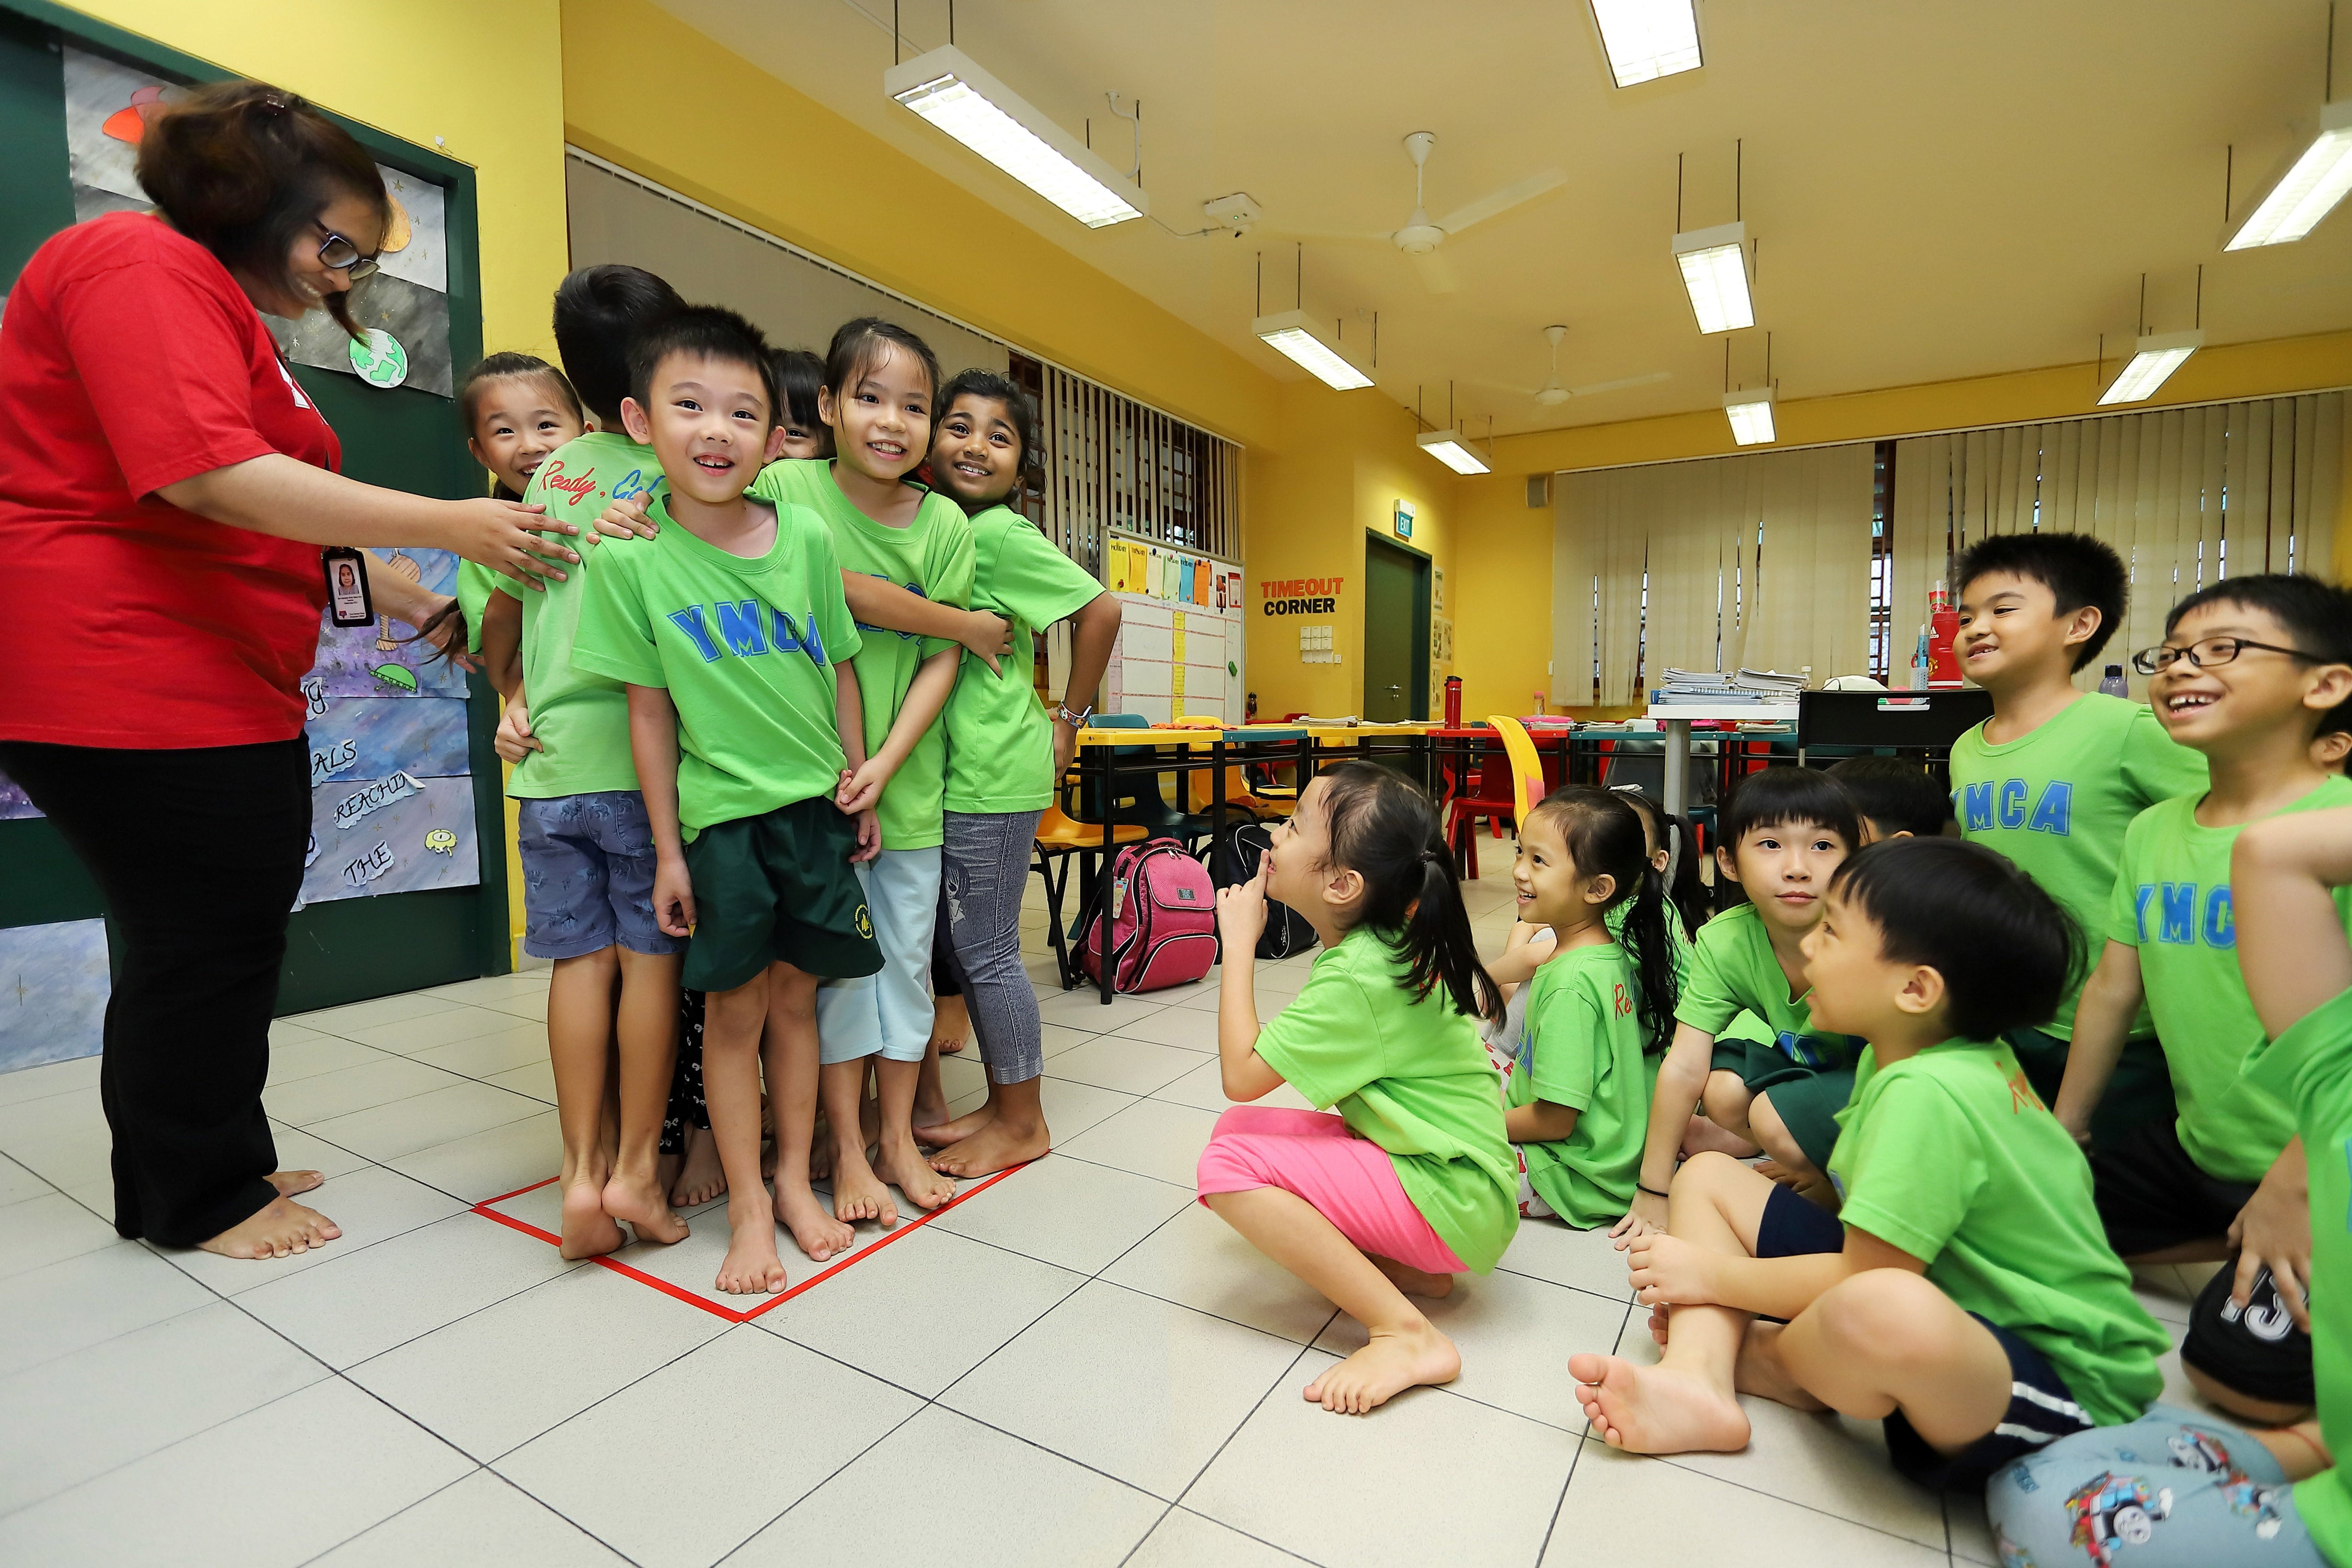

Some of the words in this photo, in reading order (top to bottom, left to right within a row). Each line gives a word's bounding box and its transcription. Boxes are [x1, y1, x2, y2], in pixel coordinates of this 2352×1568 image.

[1400, 516, 1410, 533] EXIT
[1111, 544, 1126, 552] MONDAY
[1261, 577, 1344, 598] TIMEOUT
[1264, 598, 1335, 616] CORNER
[666, 598, 825, 667] YMCA
[313, 740, 356, 776] ALS
[344, 841, 391, 883] THE
[2136, 882, 2236, 950] YMC
